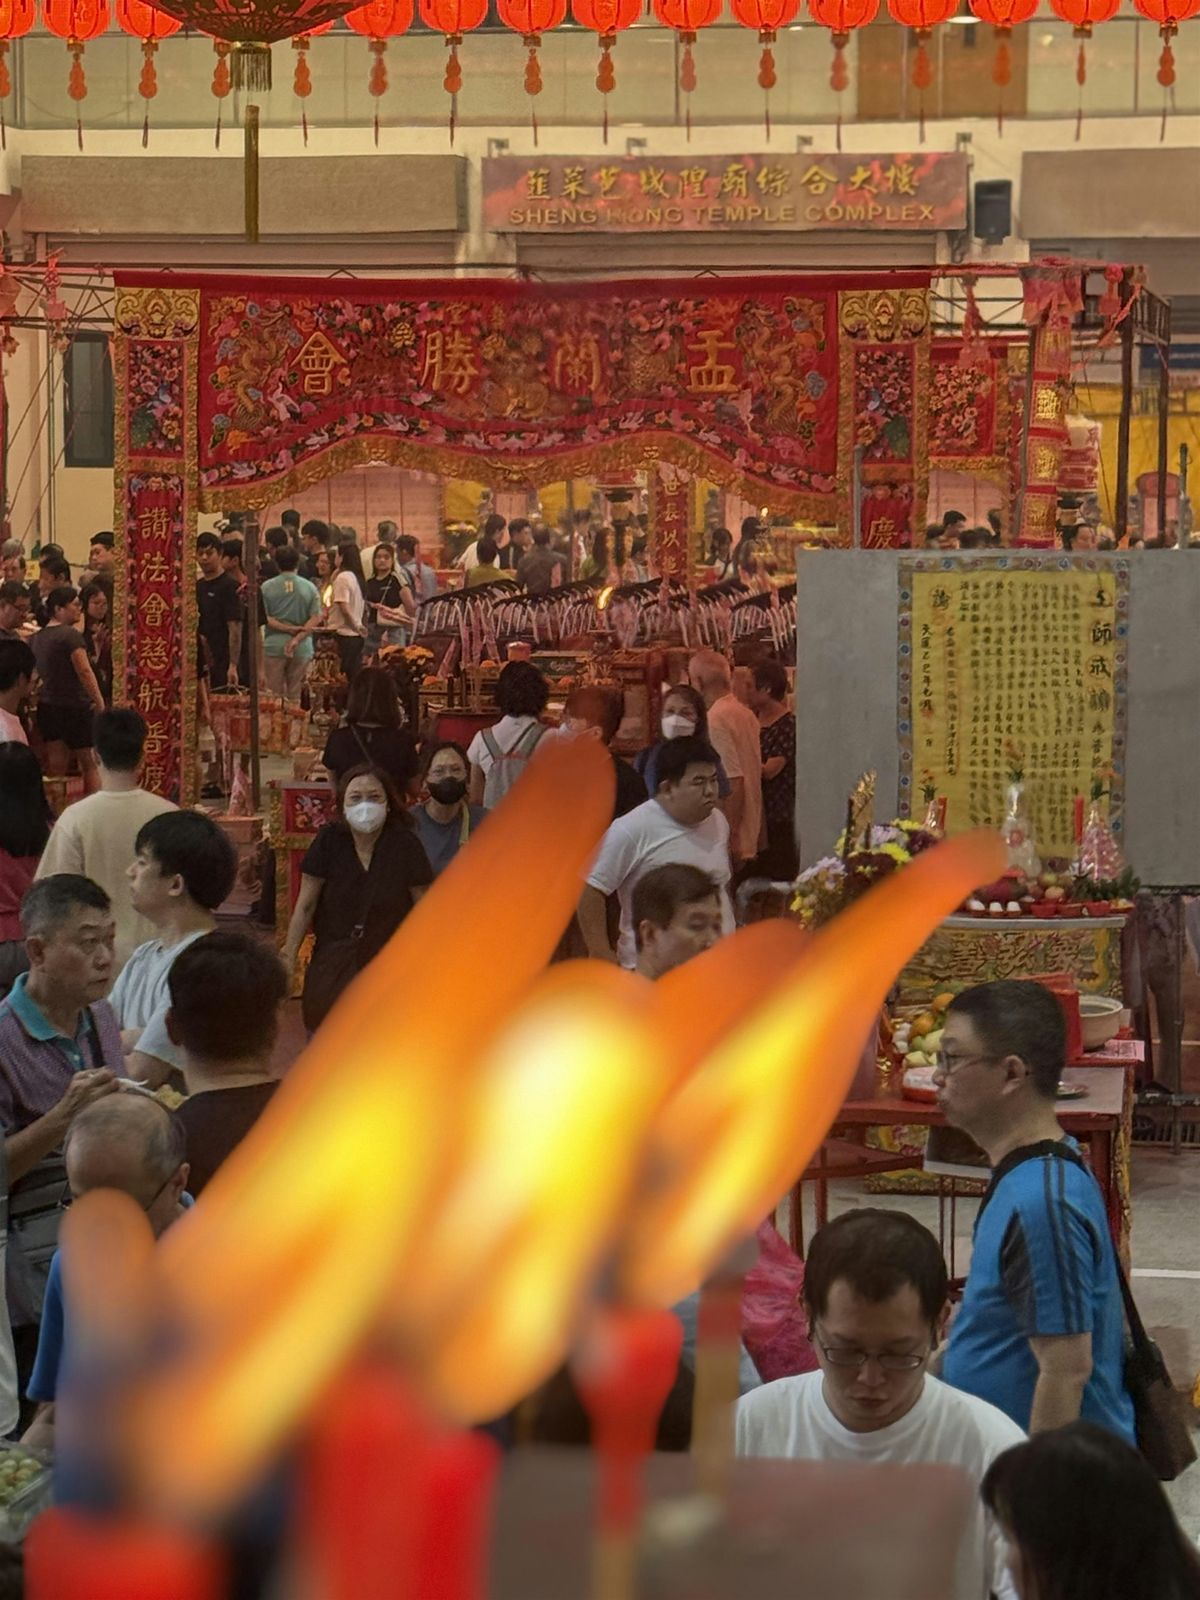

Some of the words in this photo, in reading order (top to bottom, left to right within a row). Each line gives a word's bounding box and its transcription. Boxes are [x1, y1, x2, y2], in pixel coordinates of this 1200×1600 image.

[510, 208, 598, 225] SHENG
[606, 207, 683, 224] HONG
[693, 205, 795, 223] TEMPLE
[805, 204, 935, 222] COMPLEX
